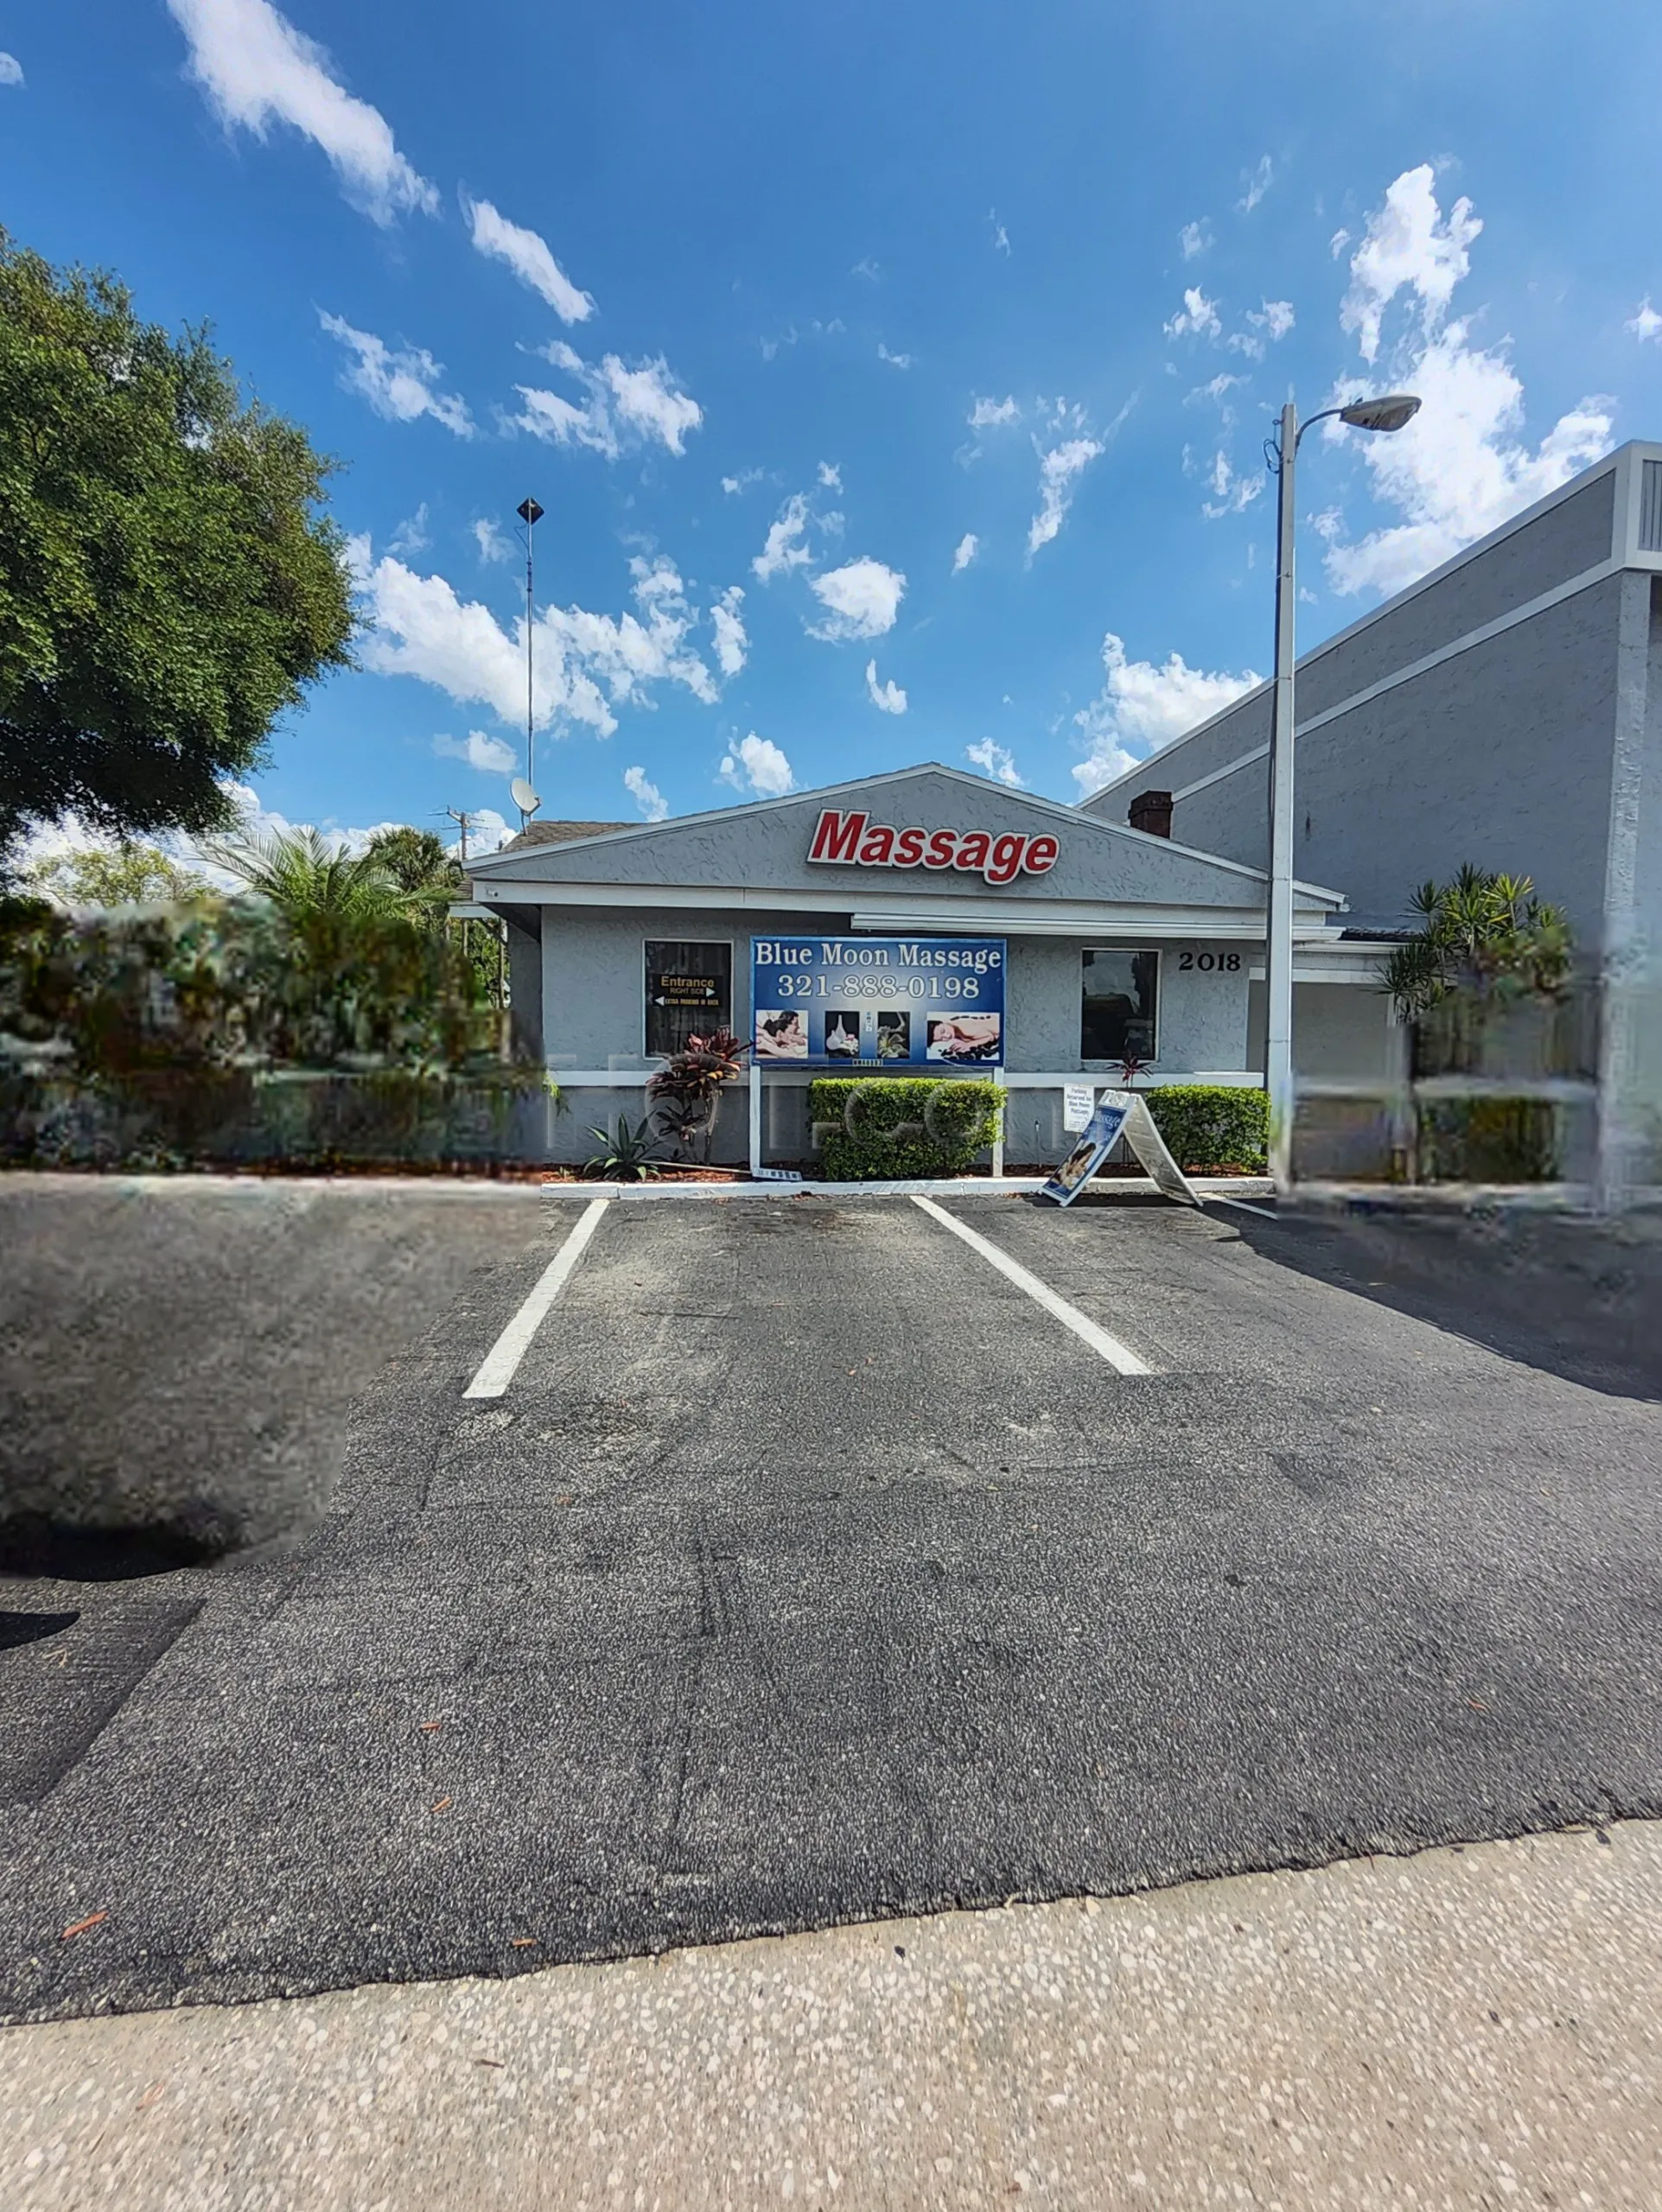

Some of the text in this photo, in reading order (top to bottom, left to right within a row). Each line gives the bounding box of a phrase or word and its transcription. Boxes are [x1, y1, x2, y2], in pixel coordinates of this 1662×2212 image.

[808, 809, 1060, 884] Massage
[755, 943, 1002, 975] Blue Moon Massage
[1179, 952, 1241, 972] 2018
[660, 976, 714, 987] Entrance
[778, 974, 980, 998] 321-888-0198
